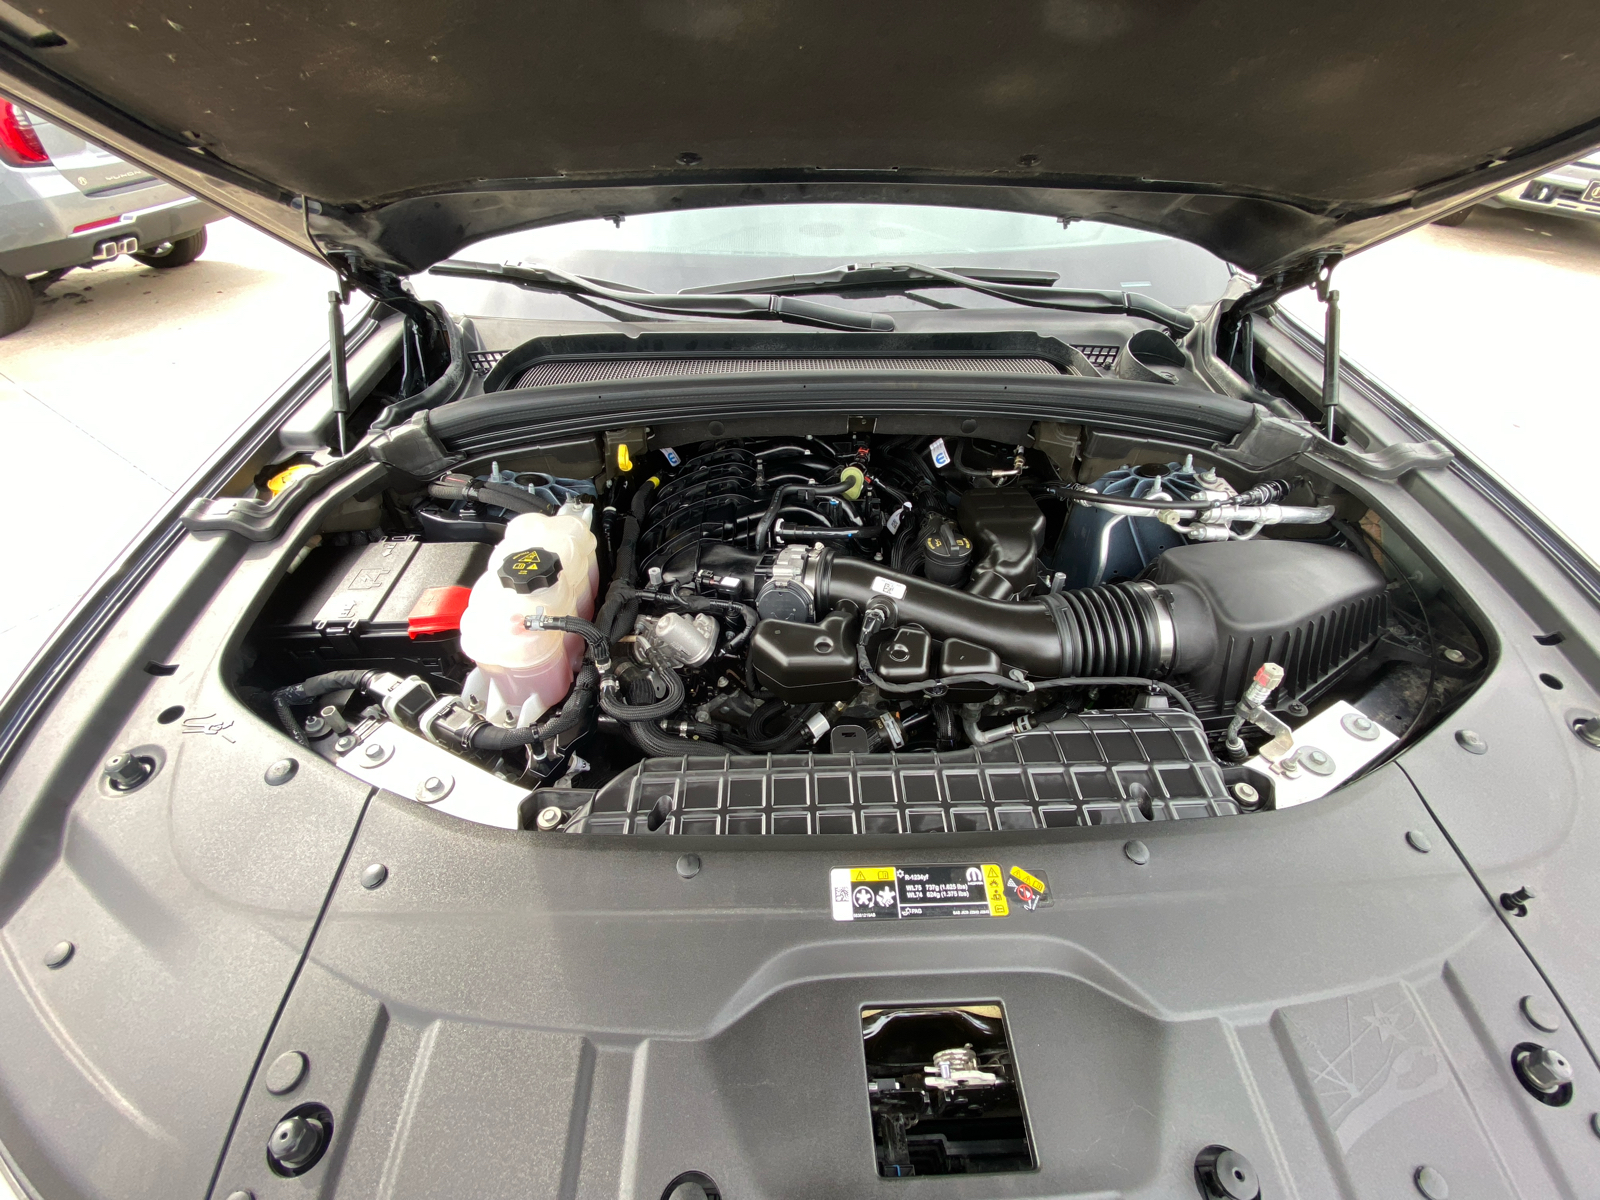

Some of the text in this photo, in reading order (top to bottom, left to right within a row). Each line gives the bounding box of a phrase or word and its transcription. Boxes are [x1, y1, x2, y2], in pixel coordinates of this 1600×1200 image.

[105, 170, 142, 181] YUKON
[925, 884, 939, 892] 737g
[907, 891, 923, 899] WL74
